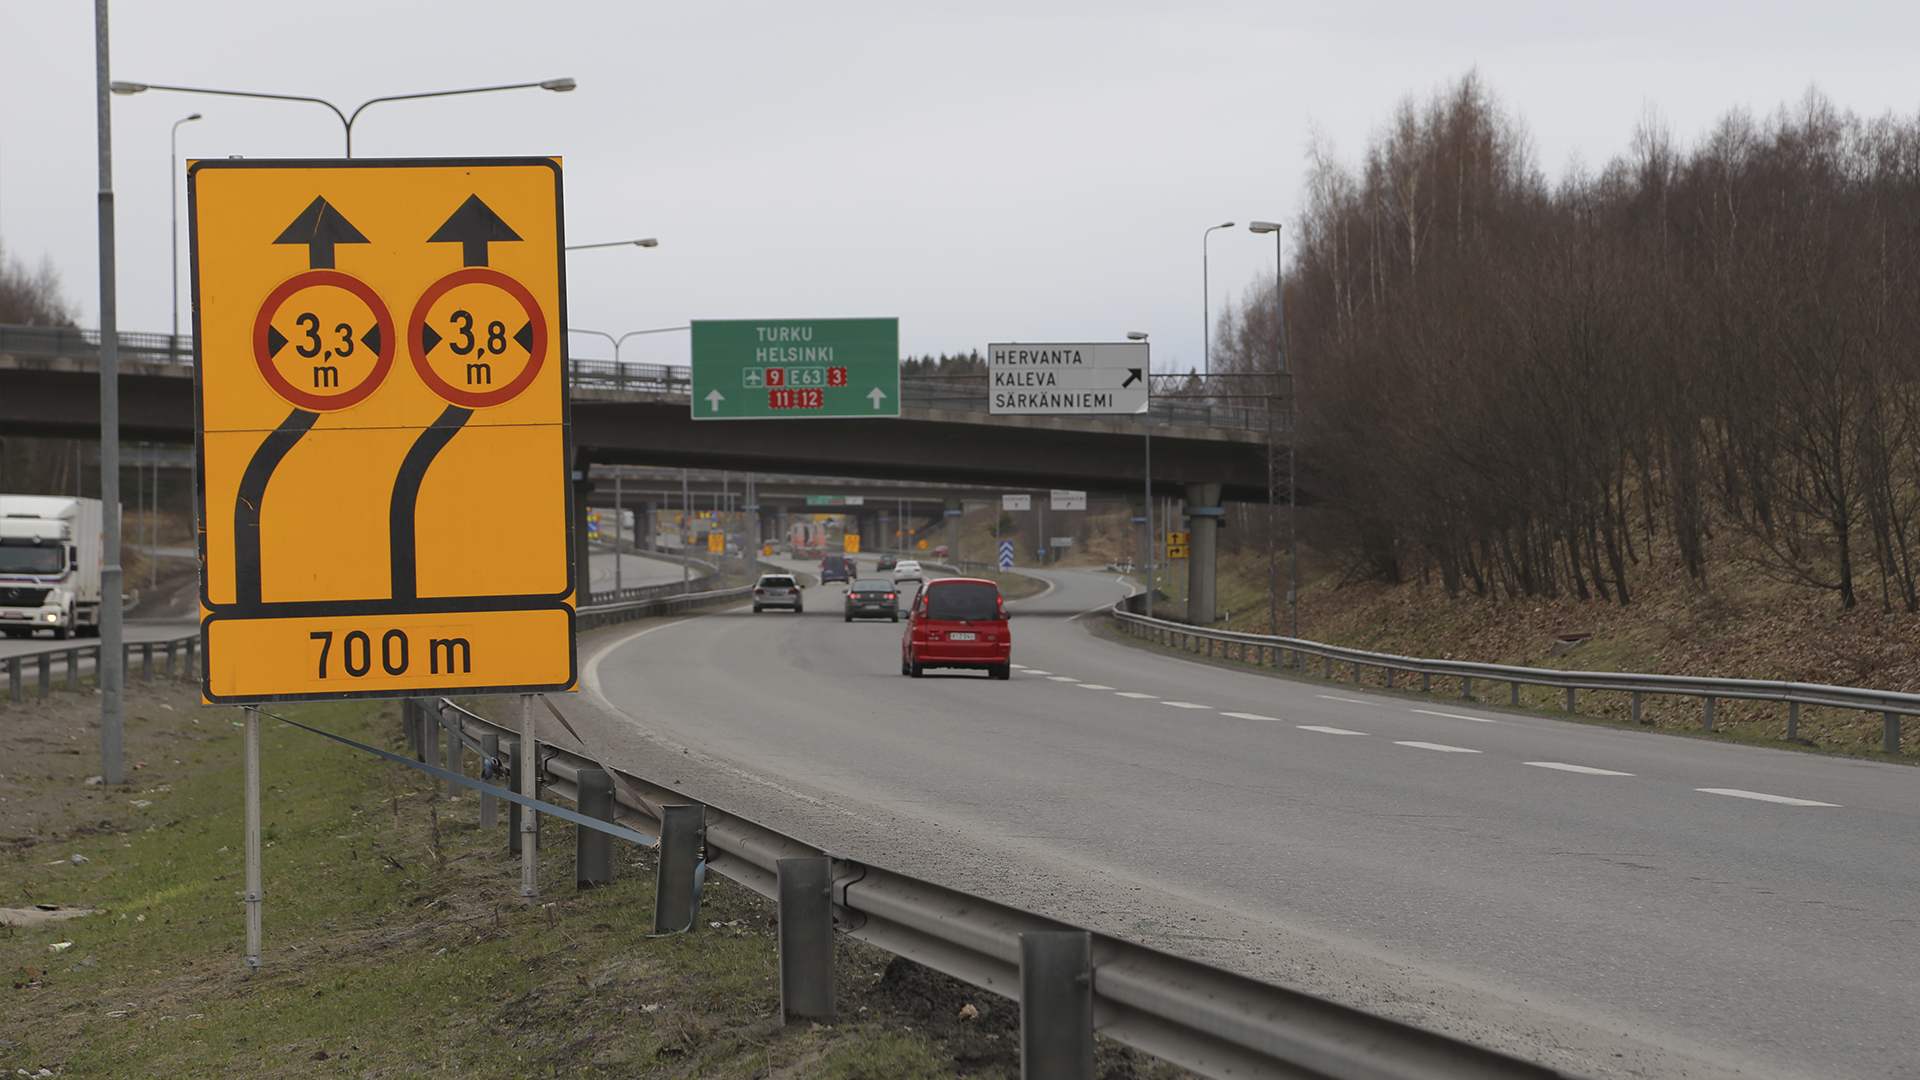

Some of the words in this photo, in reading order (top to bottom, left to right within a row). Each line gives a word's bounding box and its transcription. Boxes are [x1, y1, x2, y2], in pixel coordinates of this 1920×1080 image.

[296, 312, 354, 363] 3,3
[449, 309, 507, 360] 3,8
[756, 326, 813, 342] TURKU
[756, 346, 834, 362] HELSINKI
[995, 350, 1082, 364] HERVANTA
[313, 366, 338, 388] m
[466, 363, 491, 385] m
[769, 370, 780, 385] 9
[832, 369, 842, 384] 3
[995, 371, 1056, 386] KALEVA
[775, 391, 789, 406] 11
[802, 391, 818, 406] 12
[995, 391, 1113, 408] SÄRKÄNNIEMI
[309, 628, 409, 679] 700
[429, 637, 471, 675] m
